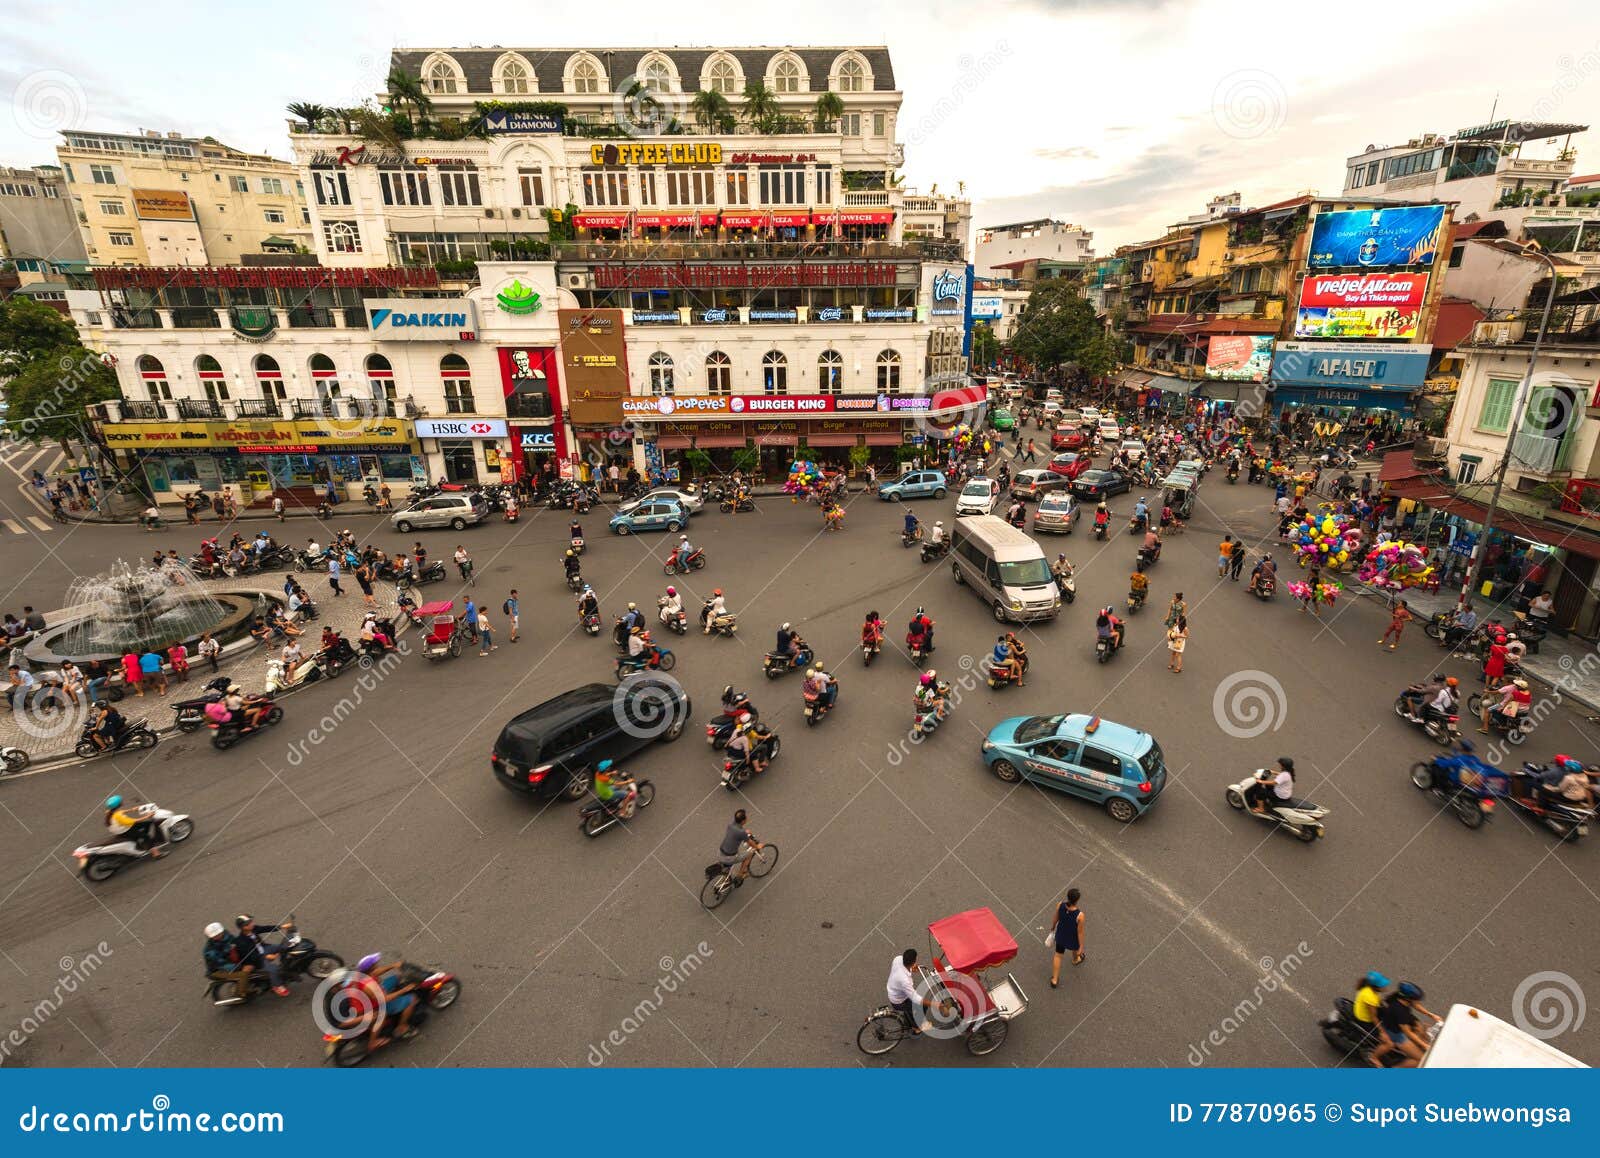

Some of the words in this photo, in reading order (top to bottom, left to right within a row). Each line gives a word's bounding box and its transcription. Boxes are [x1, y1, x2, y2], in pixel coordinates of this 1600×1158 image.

[509, 121, 558, 130] DIAMOND
[670, 143, 722, 165] CLUB
[585, 217, 616, 225] COFFEE
[636, 216, 660, 224] URGER
[677, 215, 698, 224] PAST
[726, 217, 752, 225] STEAK
[391, 313, 467, 327] DAIKIN
[749, 399, 796, 411] BURGER
[797, 399, 827, 410] KING
[431, 423, 468, 435] HSBC
[823, 421, 846, 429] Burger
[106, 433, 142, 441] SONY
[180, 431, 208, 440] Nikon
[522, 433, 555, 446] KFC
